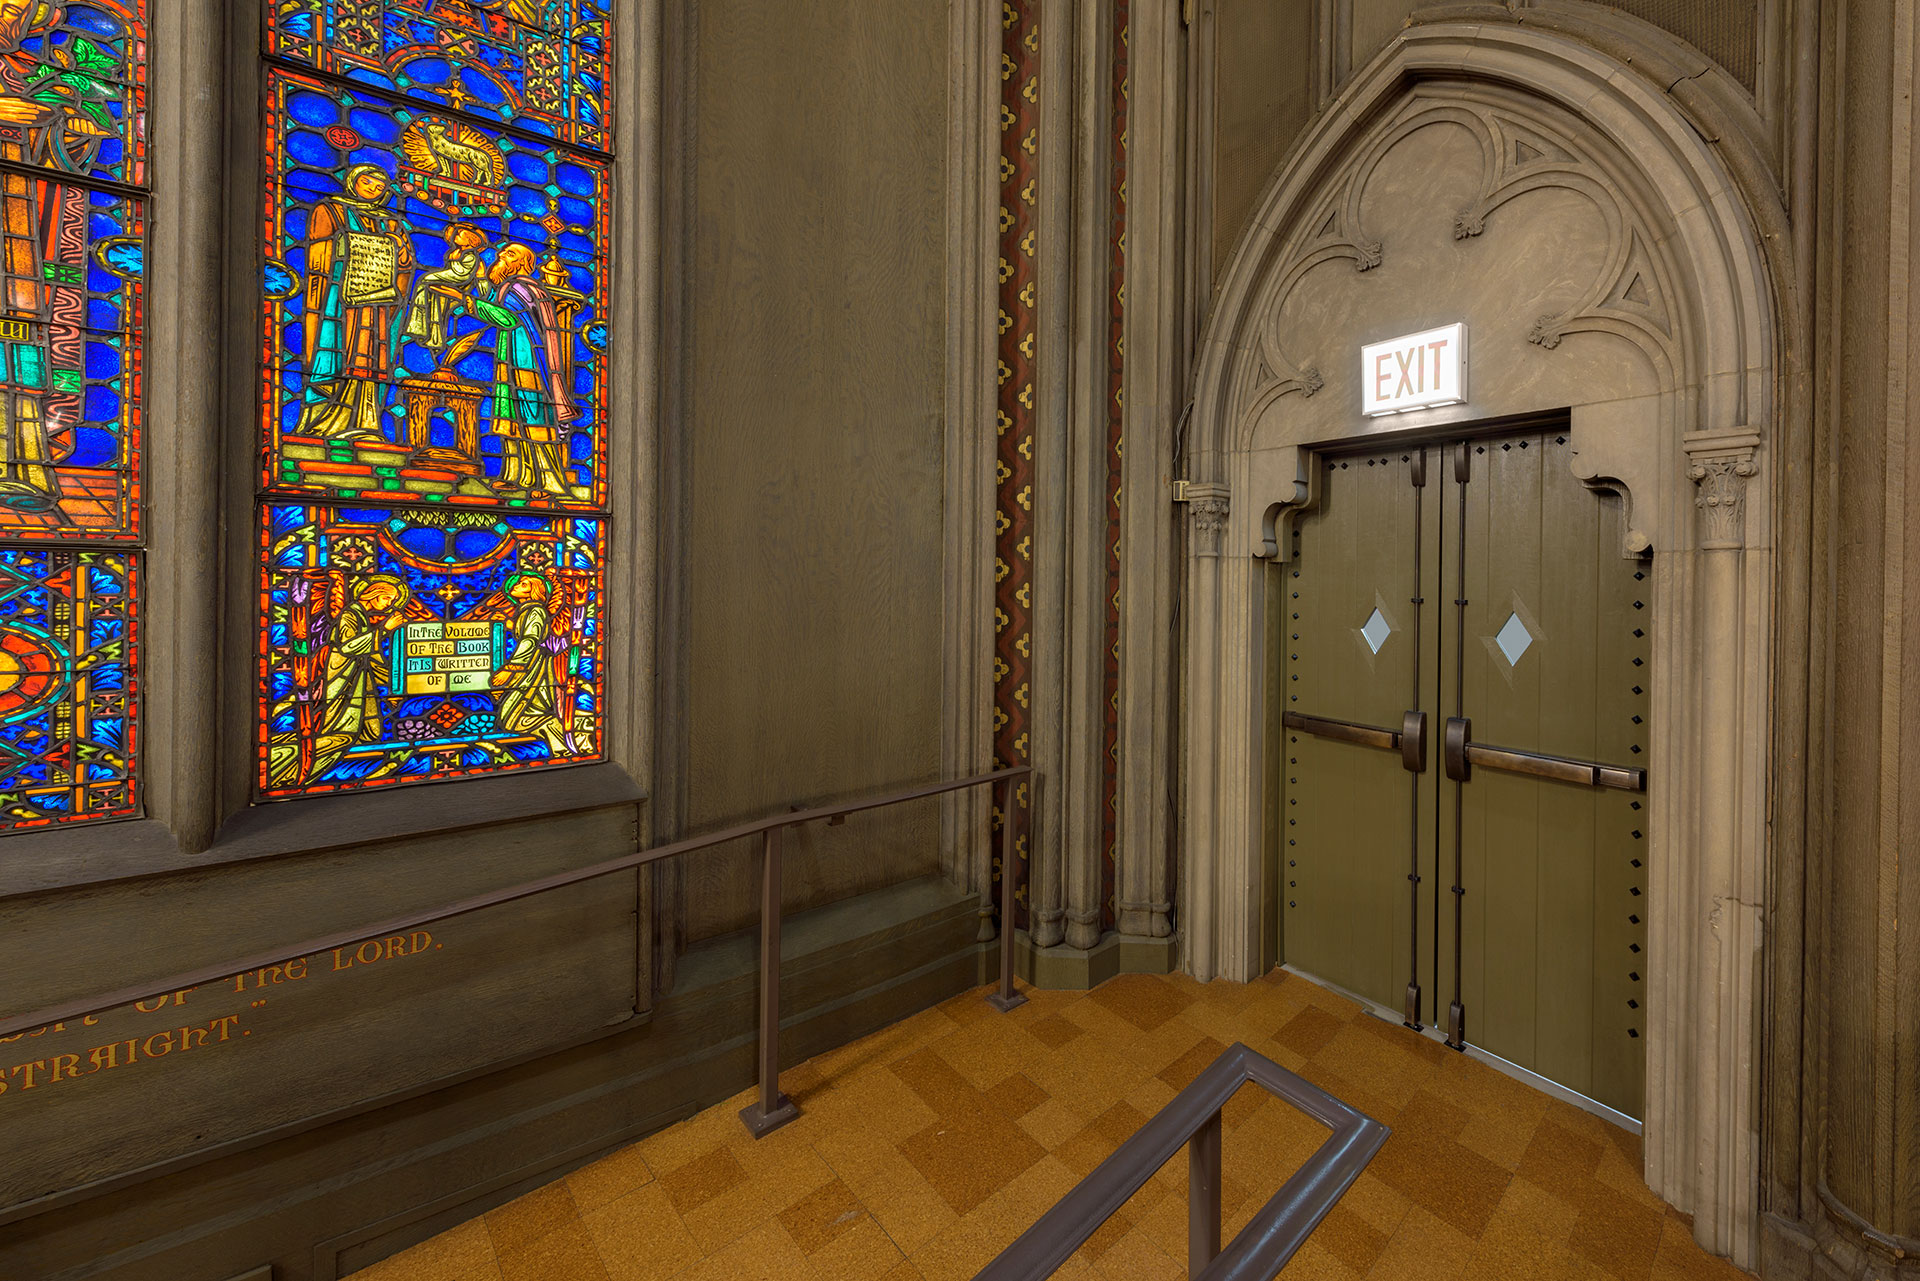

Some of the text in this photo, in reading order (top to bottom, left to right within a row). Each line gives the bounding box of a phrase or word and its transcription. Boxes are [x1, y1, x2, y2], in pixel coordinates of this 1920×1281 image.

[1375, 339, 1448, 401] EXIT
[445, 626, 490, 638] VOLUME
[409, 642, 490, 655] OF THE BOOK
[437, 658, 490, 669] WRITTEN
[427, 674, 472, 686] OF ME
[330, 931, 443, 972] LORD.
